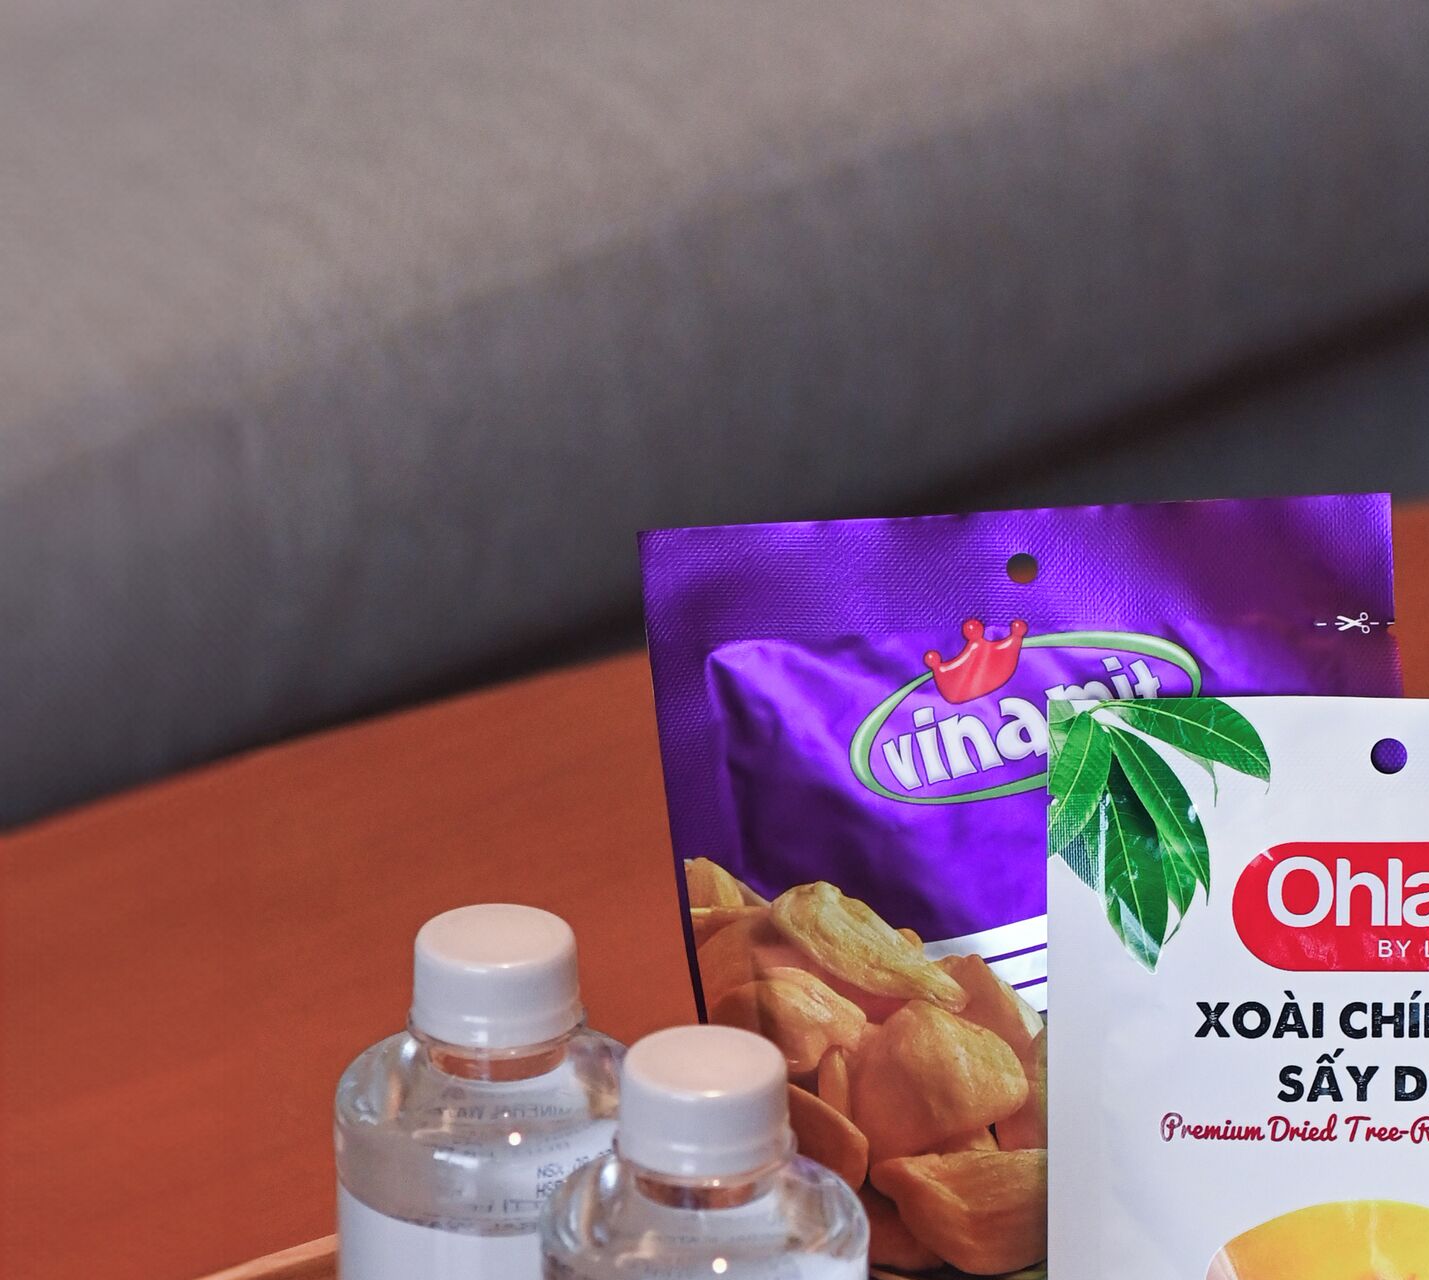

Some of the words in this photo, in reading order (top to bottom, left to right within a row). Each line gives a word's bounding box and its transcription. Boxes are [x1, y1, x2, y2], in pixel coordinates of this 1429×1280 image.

[882, 656, 1163, 791] vinait
[1378, 939, 1411, 958] BY
[1194, 990, 1324, 1039] XOÀI
[1277, 1048, 1379, 1102] SẤY
[1160, 1111, 1266, 1144] Premium
[1267, 1113, 1337, 1143] Dried
